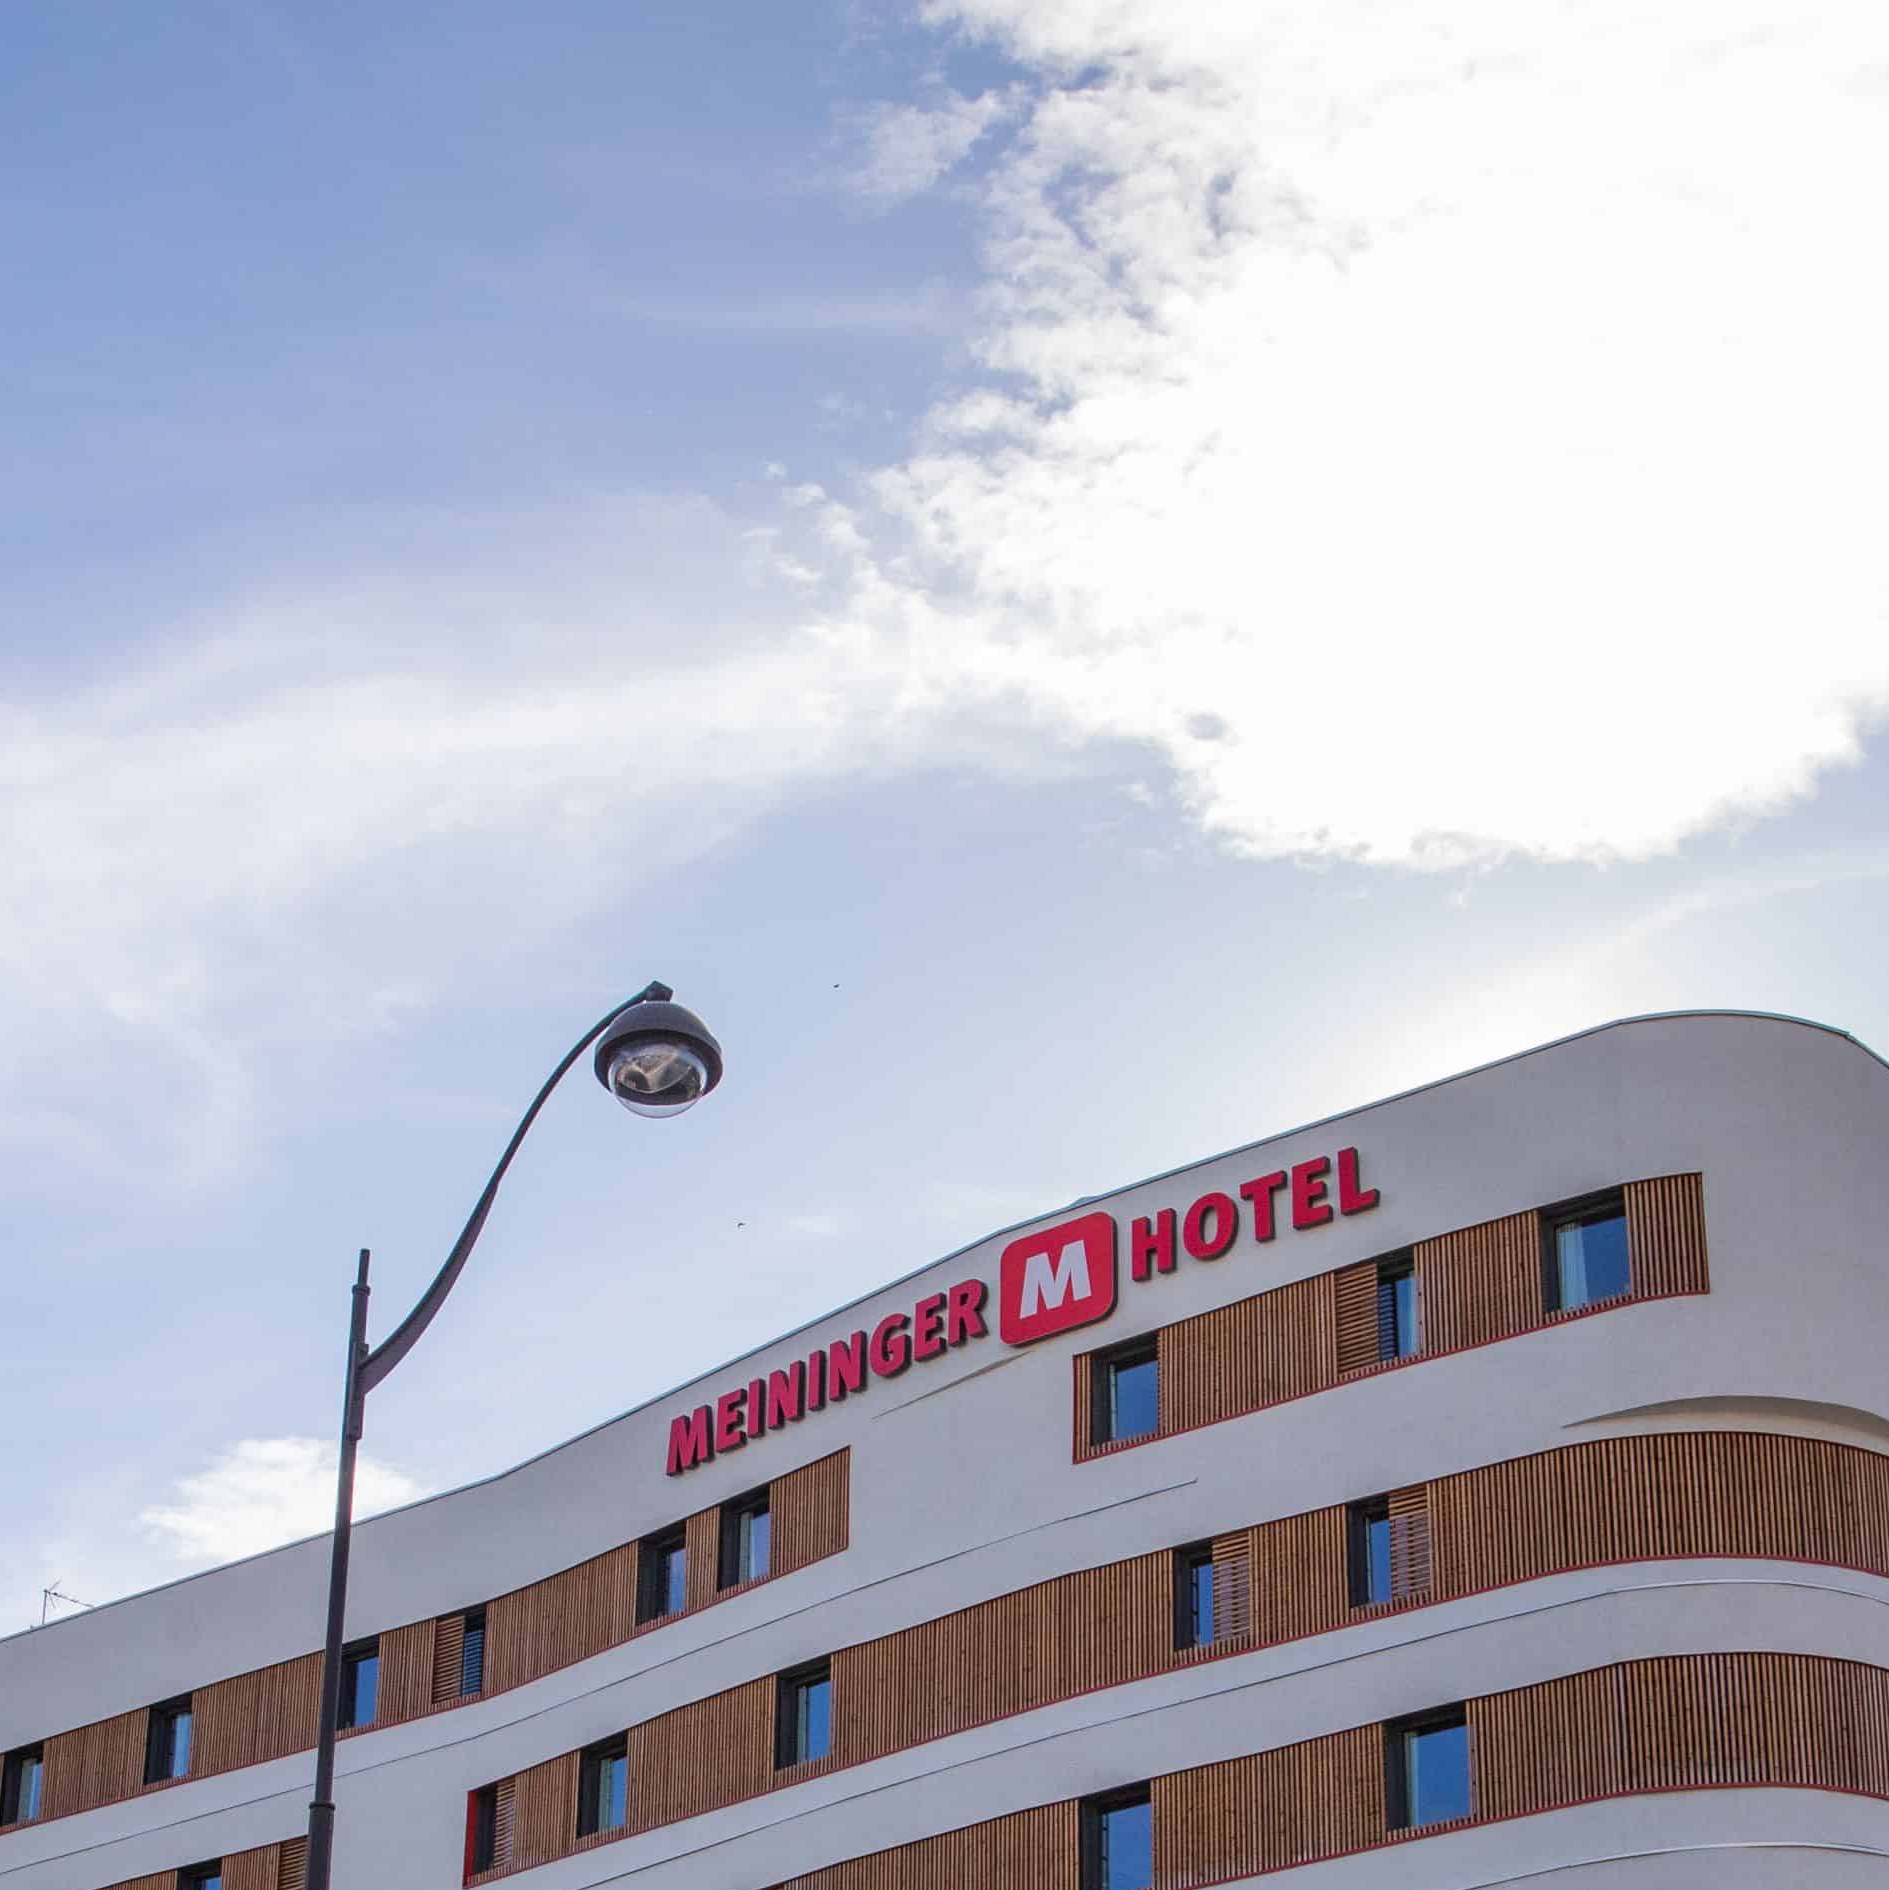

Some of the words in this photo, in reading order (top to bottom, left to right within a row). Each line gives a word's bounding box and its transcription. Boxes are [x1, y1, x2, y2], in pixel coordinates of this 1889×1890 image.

[665, 1277, 989, 1477] MEININGER
[1019, 1239, 1093, 1321] M
[1131, 1146, 1380, 1282] HOTEL
